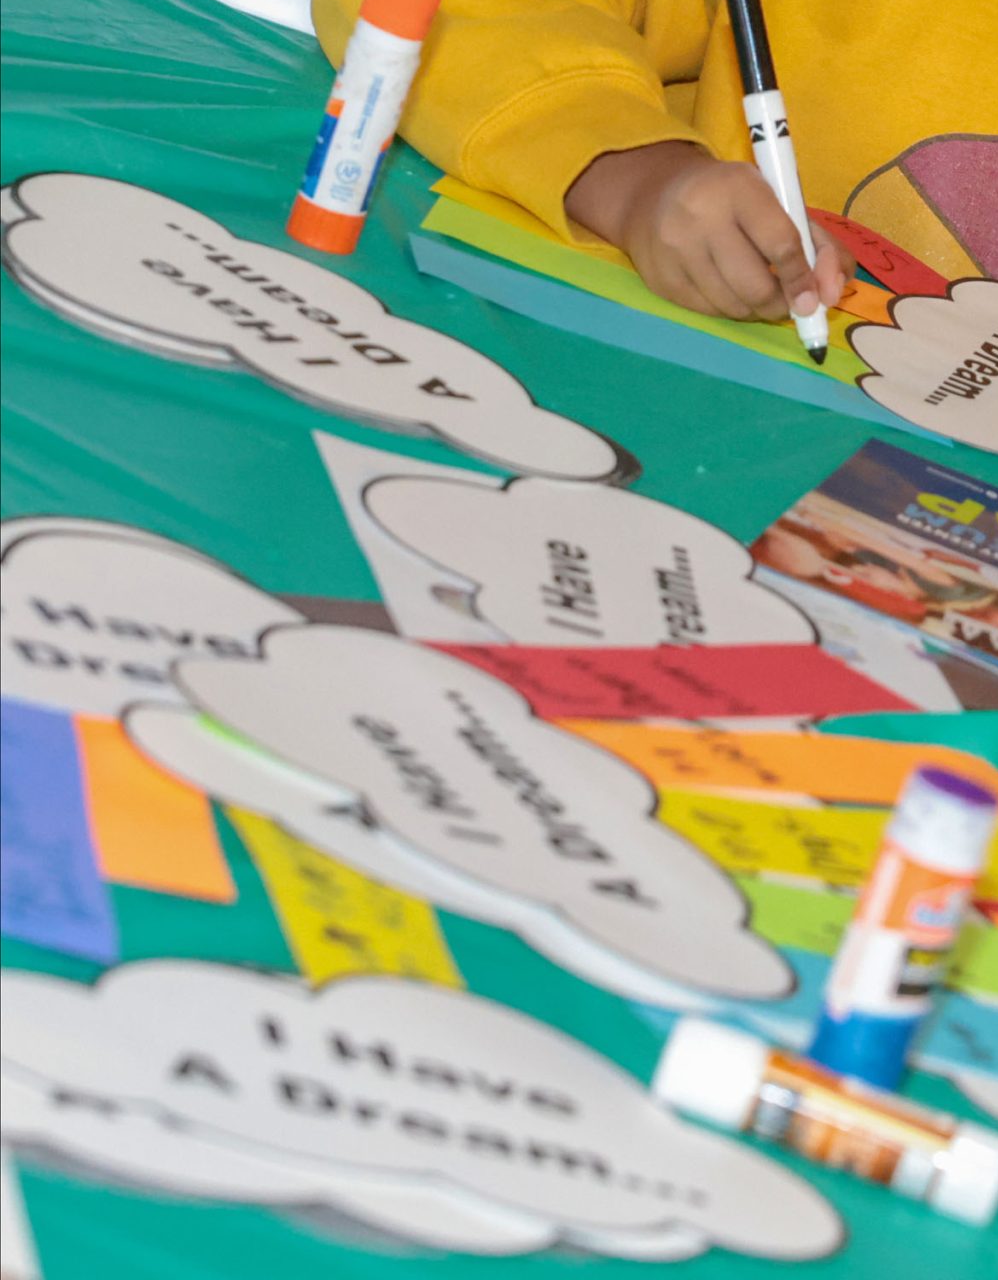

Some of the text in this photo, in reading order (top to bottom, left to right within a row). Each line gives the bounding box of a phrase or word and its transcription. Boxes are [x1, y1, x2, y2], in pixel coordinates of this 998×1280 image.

[140, 258, 340, 367] I Have
[415, 377, 476, 402] A
[897, 513, 977, 550] CENTER
[539, 539, 605, 639] I Have
[653, 545, 708, 647] ream...
[29, 596, 254, 659] Have
[351, 714, 477, 820] Have
[445, 825, 504, 845] I
[589, 878, 661, 910] A
[168, 1050, 241, 1096] A
[258, 1013, 580, 1117] I Have
